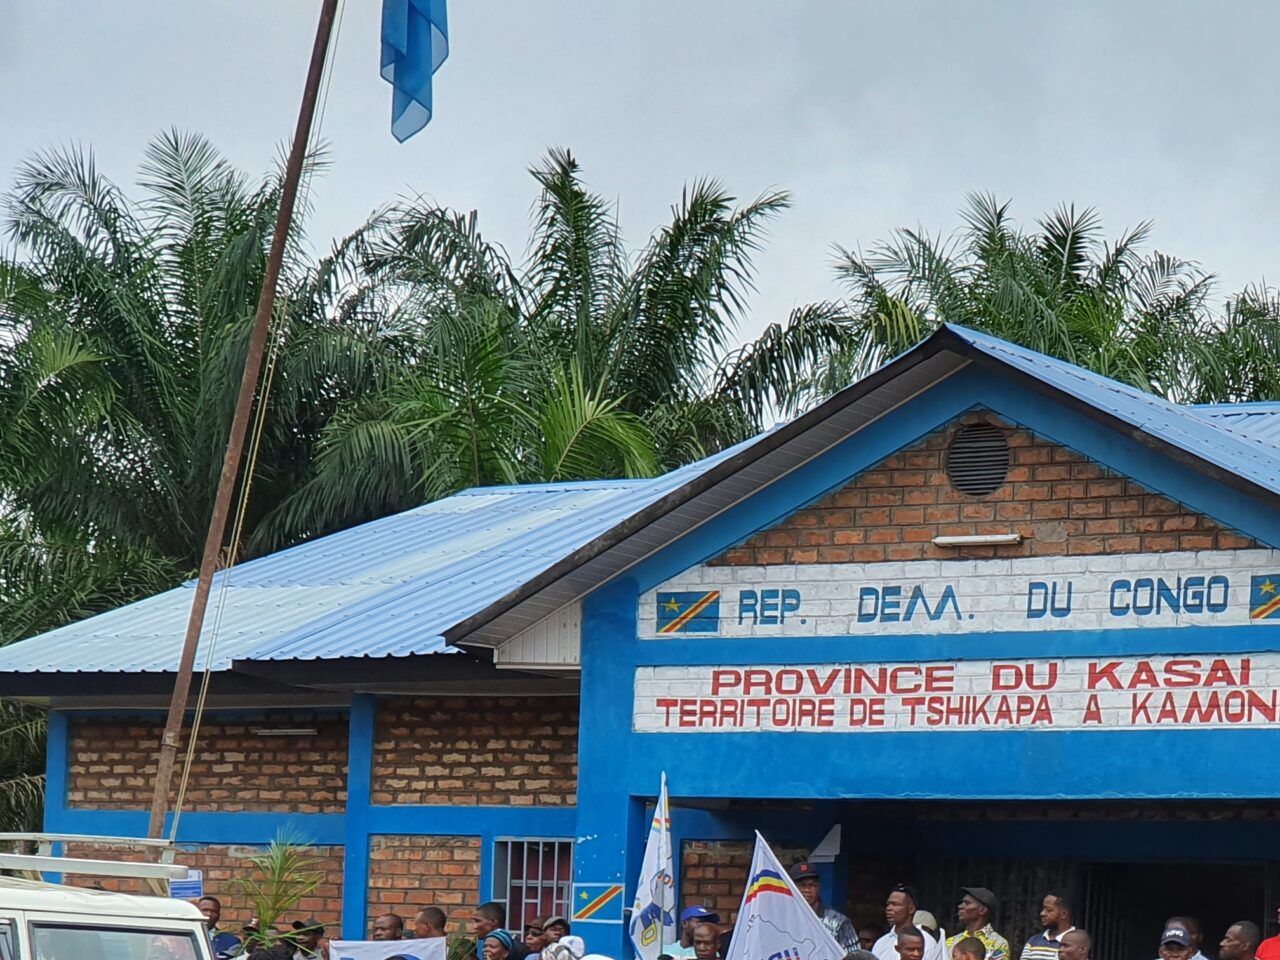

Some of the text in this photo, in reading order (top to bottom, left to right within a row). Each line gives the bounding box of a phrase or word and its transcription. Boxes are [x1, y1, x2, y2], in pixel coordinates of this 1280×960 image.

[738, 588, 807, 626] REP.
[1026, 580, 1073, 619] DU
[1108, 575, 1230, 617] CONGO
[710, 658, 1251, 696] PROVINCE DU KASAI
[655, 697, 835, 728] TERRITOIRE
[849, 697, 886, 727] DE
[900, 693, 1053, 727] TSHIKAPA
[1082, 693, 1102, 725] A
